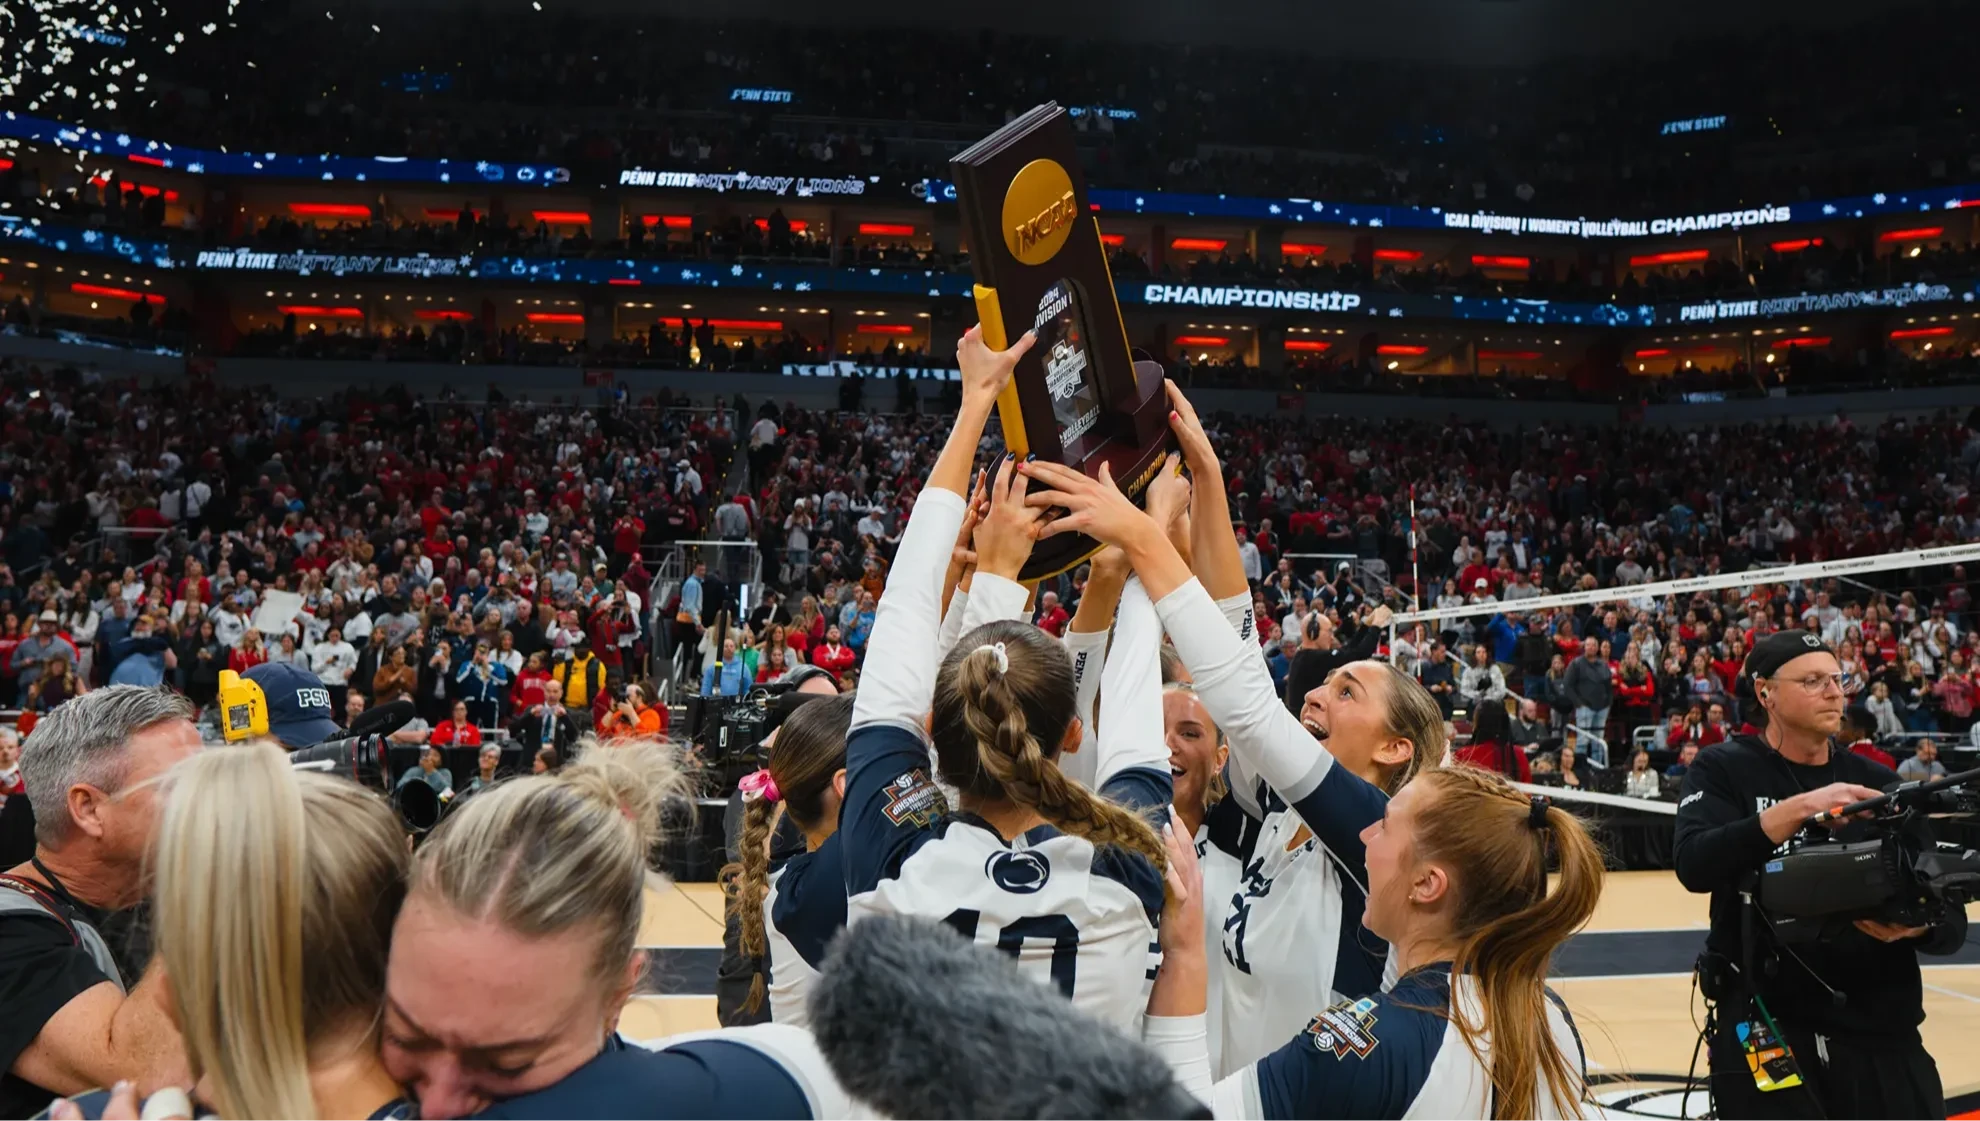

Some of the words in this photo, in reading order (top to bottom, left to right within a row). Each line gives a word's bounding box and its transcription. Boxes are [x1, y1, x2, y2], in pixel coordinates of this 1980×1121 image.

[620, 170, 656, 187] PENN
[657, 172, 696, 188] STATE
[697, 173, 793, 193] NITTANY
[796, 177, 866, 196] LIONS
[1015, 190, 1077, 256] NCAA
[1471, 214, 1521, 233] DIVISION
[1521, 217, 1527, 231] I
[1528, 218, 1580, 235] WOMEN'S
[1582, 219, 1649, 237] VOLLEYBALL
[1650, 206, 1791, 235] CHAMPIONS
[196, 251, 233, 268] PENN
[235, 252, 278, 269] STATE
[278, 254, 382, 274] NITTANY
[1038, 286, 1059, 310] 2024
[1144, 284, 1361, 311] CHAMPIONSHIP
[1680, 303, 1717, 320] PENN
[1718, 301, 1758, 318] STATE
[1062, 404, 1101, 441] VOLLEYBALL
[296, 688, 332, 710] PSU
[1854, 852, 1877, 862] SONY
